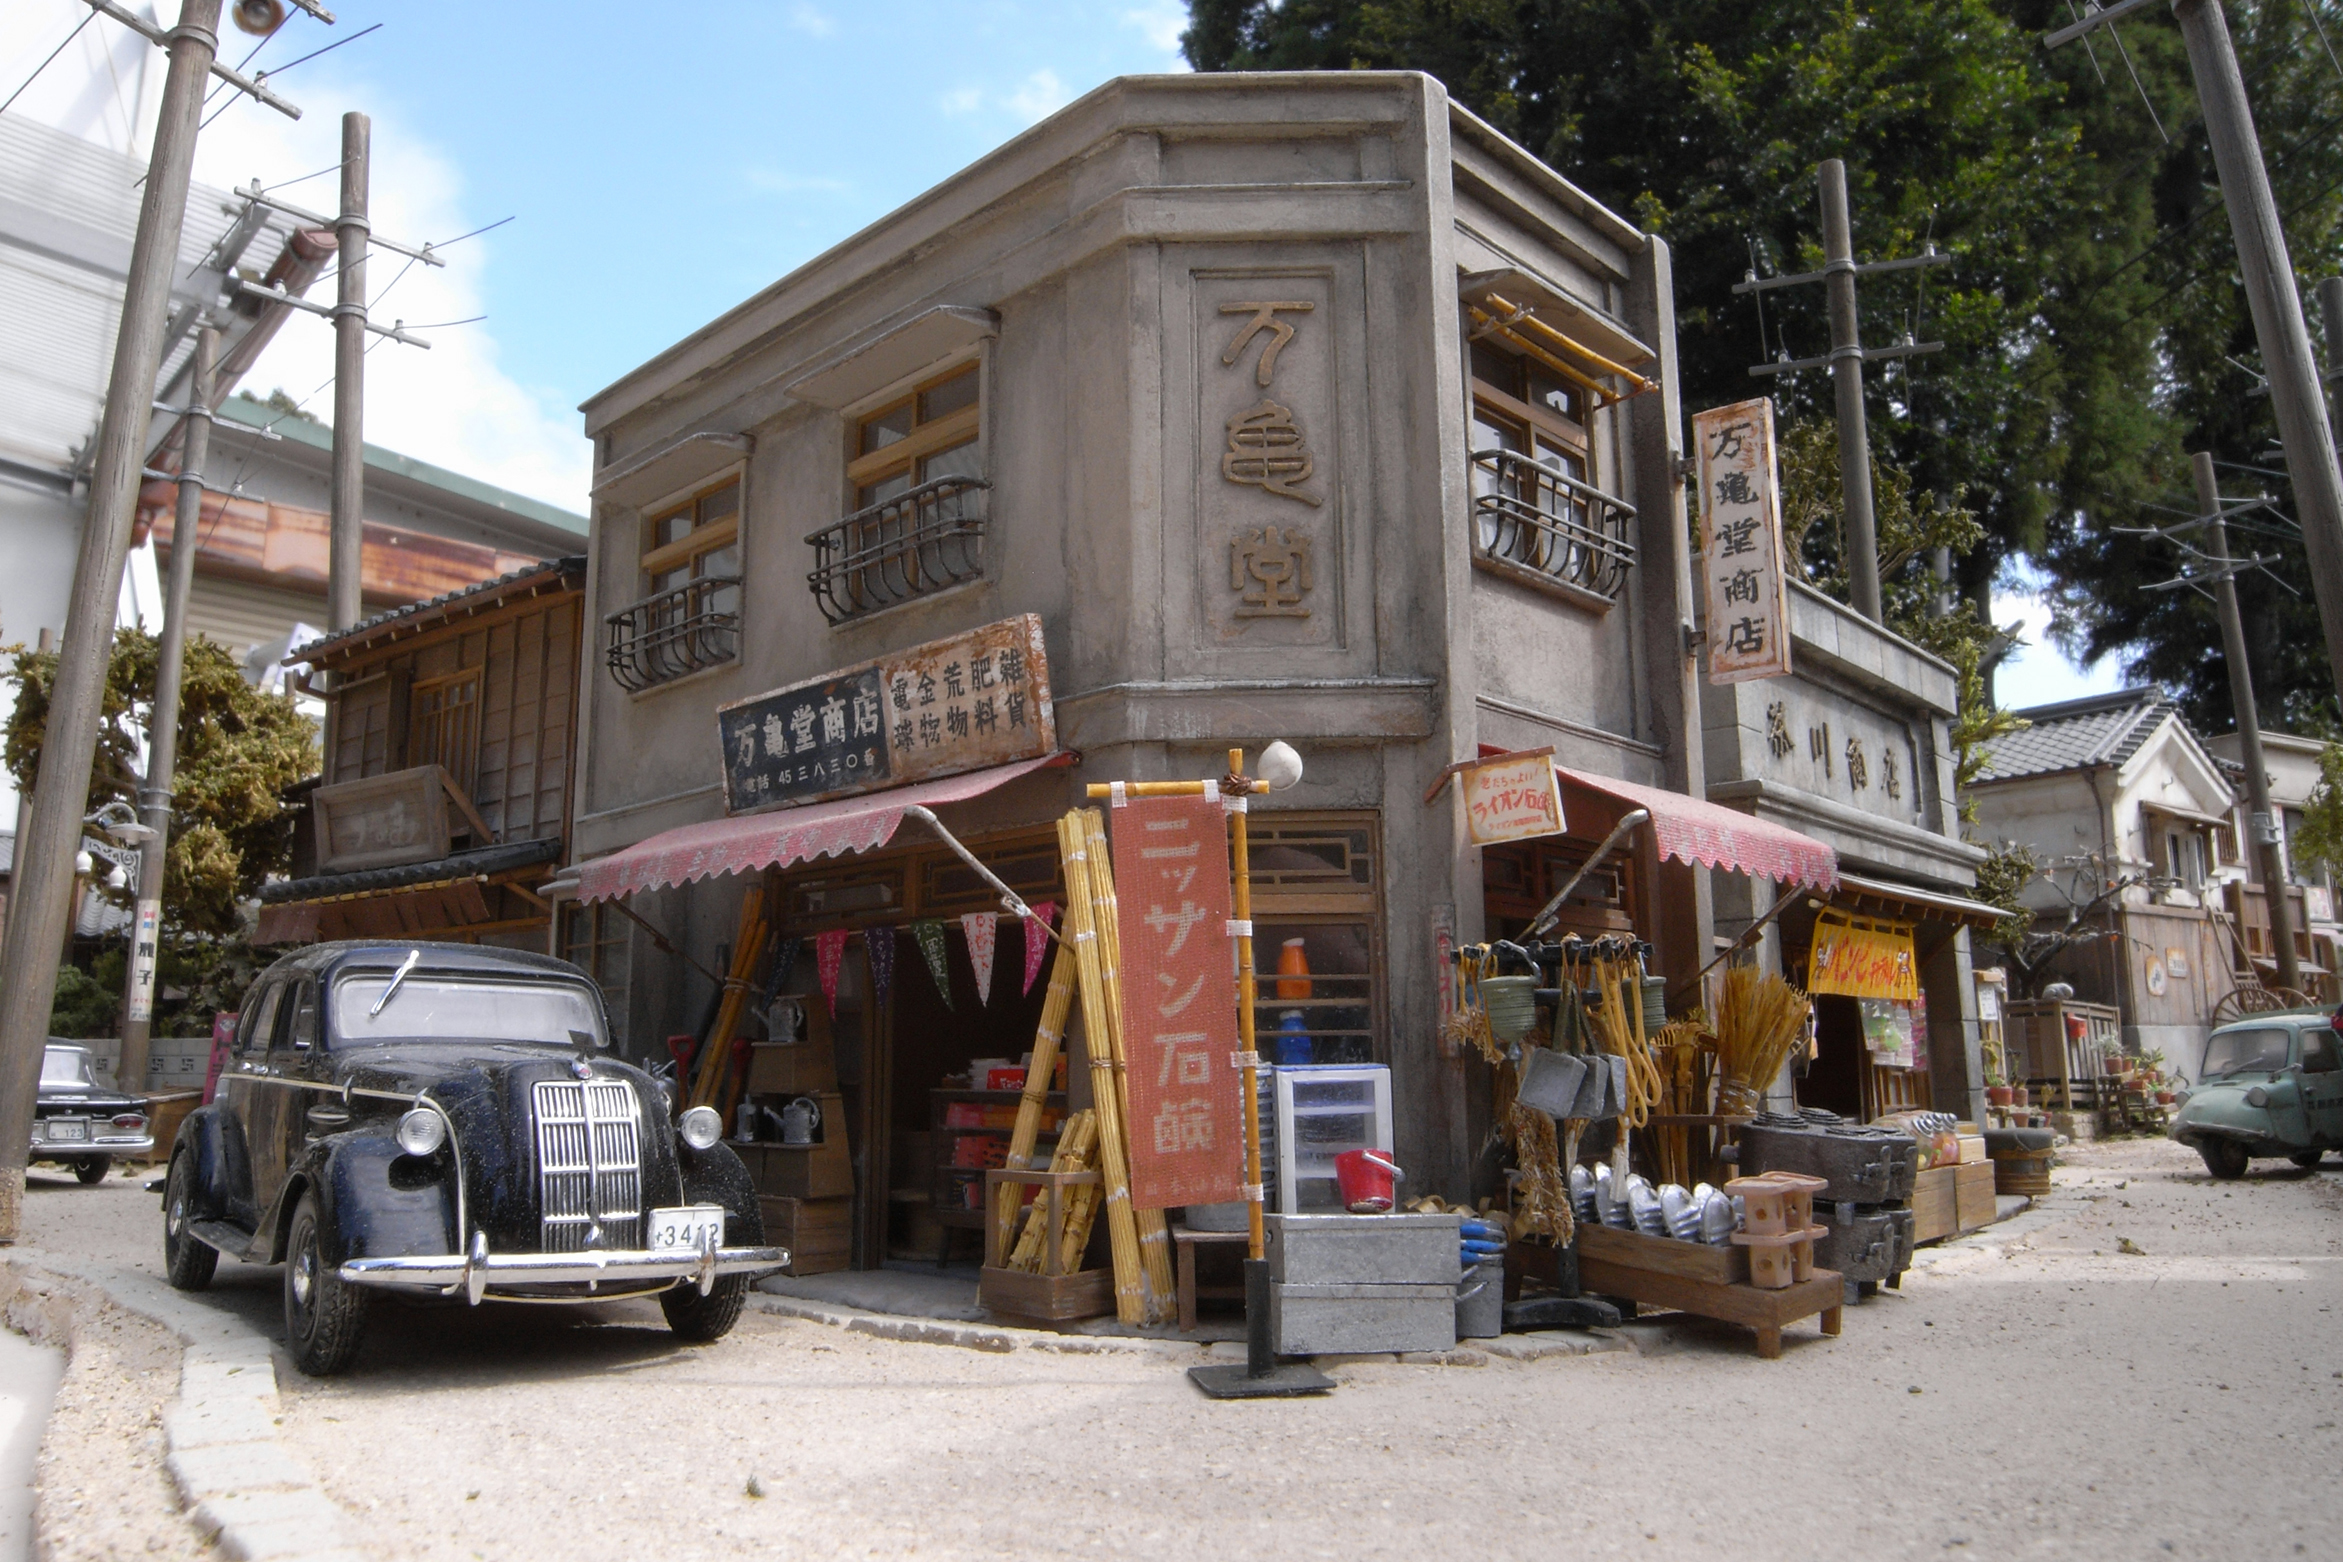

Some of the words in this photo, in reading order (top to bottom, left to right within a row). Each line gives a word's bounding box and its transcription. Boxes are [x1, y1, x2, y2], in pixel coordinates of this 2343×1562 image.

[1218, 300, 1324, 618] 万亀堂
[890, 677, 915, 753] 電球
[916, 671, 941, 748] 金物
[943, 661, 968, 738] 荒物
[970, 655, 999, 736] 肥料
[778, 769, 792, 785] 45
[65, 1129, 84, 1137] 123
[665, 1223, 719, 1246] 342
